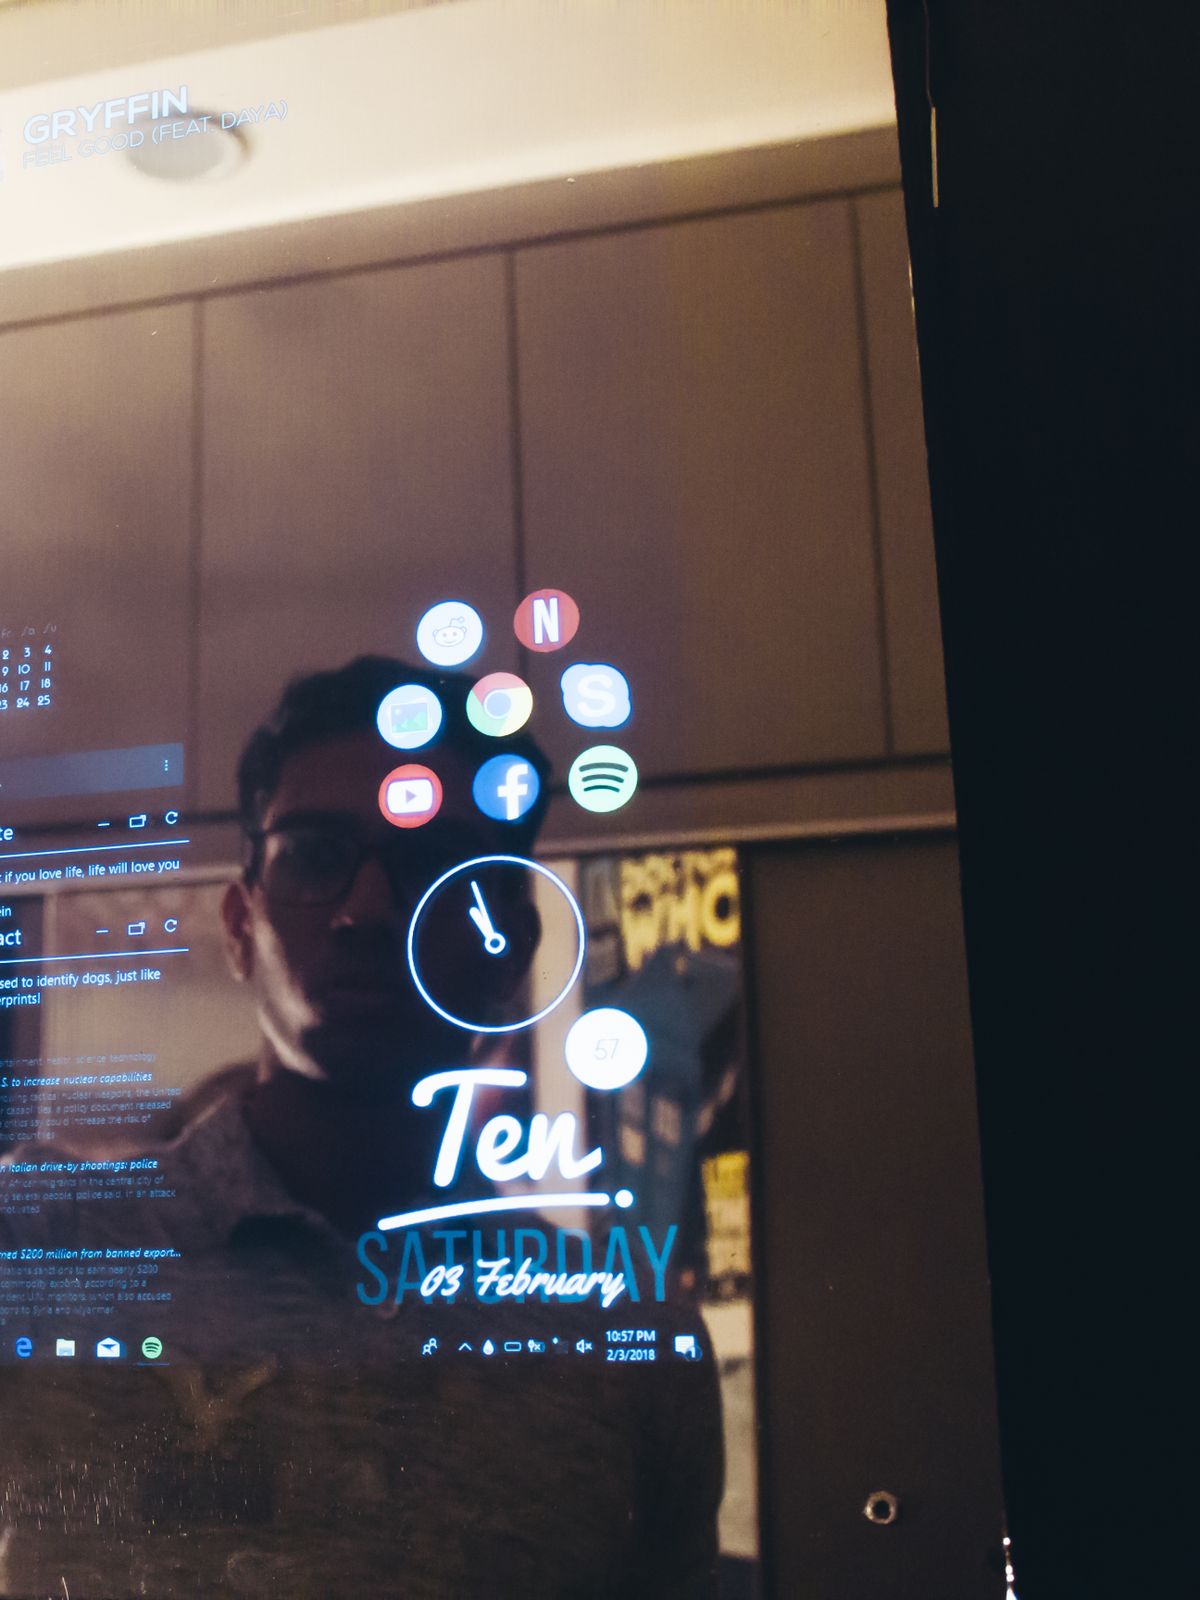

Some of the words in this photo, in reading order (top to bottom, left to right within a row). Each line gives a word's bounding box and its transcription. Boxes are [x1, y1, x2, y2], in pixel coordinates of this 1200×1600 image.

[23, 85, 188, 145] GRYFFIN
[22, 144, 72, 170] FEEL
[77, 130, 144, 159] GOOD
[152, 116, 210, 145] (FEAT.
[222, 99, 288, 129] DAYA)
[3, 650, 9, 659] 2
[24, 647, 30, 657] 3
[45, 645, 51, 654] 4
[2, 666, 8, 676] 9
[18, 664, 30, 674] 10
[45, 661, 51, 671] 11
[0, 683, 8, 693] 16
[20, 681, 30, 690] 17
[41, 678, 50, 688] 18
[17, 698, 29, 708] 24
[38, 695, 50, 706] 25
[5, 872, 13, 883] if
[15, 871, 36, 886] you
[39, 868, 61, 880] love
[65, 867, 85, 880] life,
[88, 865, 105, 876] life
[109, 863, 127, 874] will
[131, 860, 155, 872] love
[158, 860, 180, 874] you
[22, 977, 34, 988] to
[37, 973, 79, 988] identify
[82, 972, 112, 986] dogs,
[116, 970, 137, 985] just
[140, 969, 161, 980] like
[594, 1038, 620, 1061] 57
[24, 1076, 60, 1087] increase
[64, 1076, 98, 1084] nuclear
[100, 1072, 152, 1084] capabilities
[412, 1068, 602, 1187] Ten
[8, 1162, 38, 1173] Italian
[40, 1162, 78, 1173] drive-by
[80, 1160, 127, 1172] shootings:
[130, 1159, 158, 1171] police
[20, 1248, 43, 1259] $200
[46, 1249, 78, 1259] million
[80, 1248, 102, 1260] from
[106, 1248, 141, 1258] banned
[144, 1248, 181, 1260] export...
[356, 1224, 678, 1305] SATURDAY
[420, 1264, 464, 1298] 03
[476, 1257, 626, 1308] February
[606, 1330, 634, 1342] 10:57
[636, 1330, 655, 1341] PM
[607, 1349, 655, 1361] 2/3/2018
